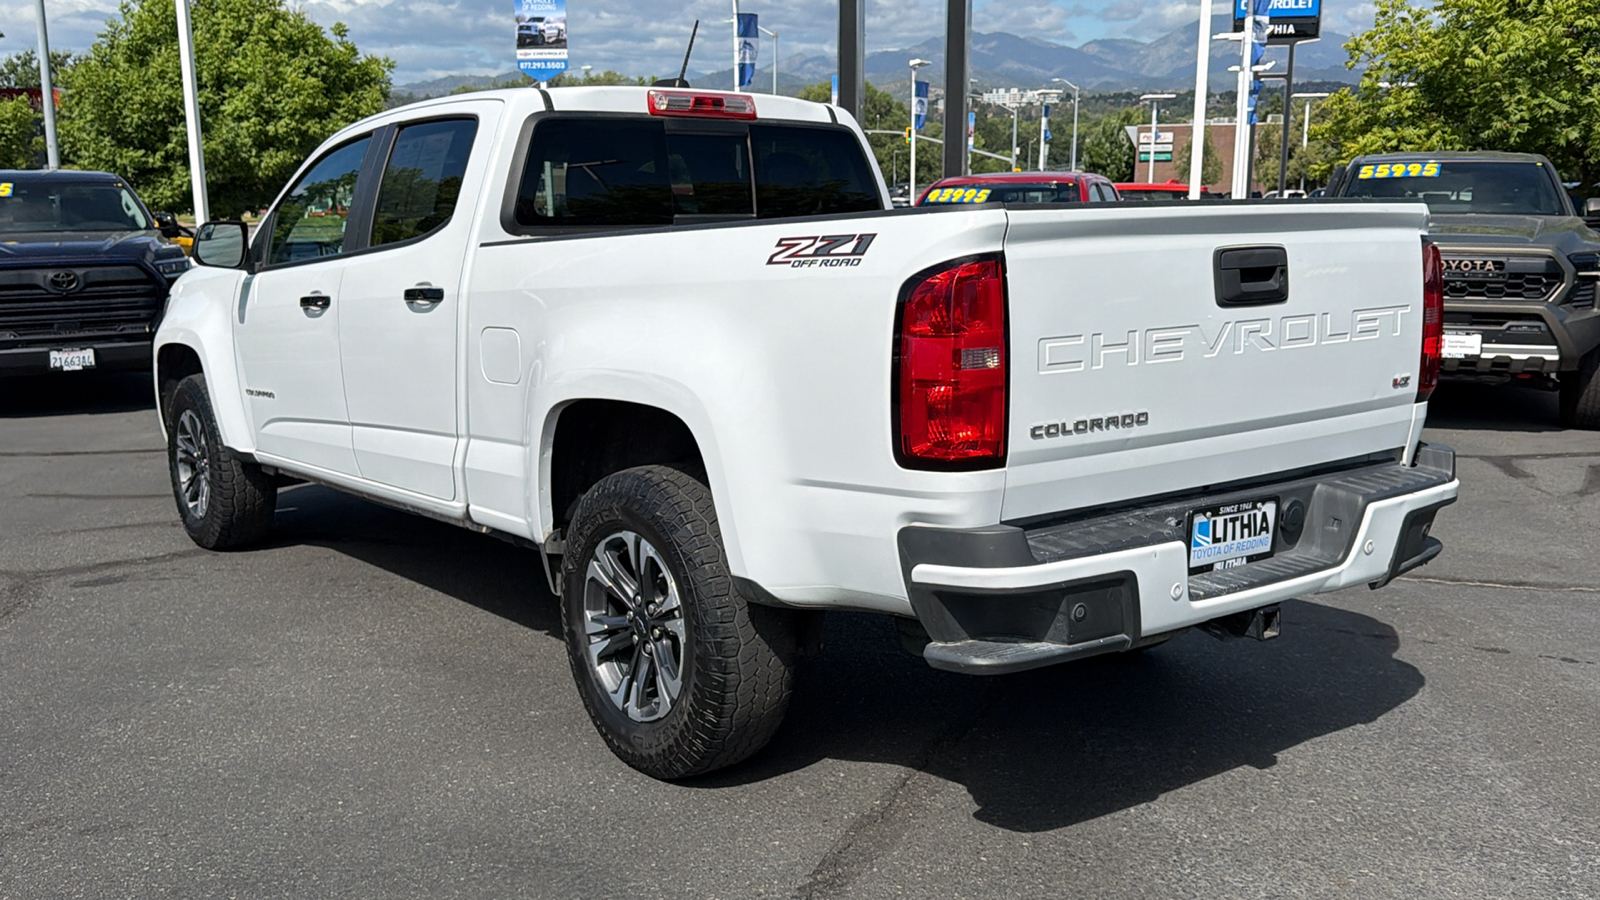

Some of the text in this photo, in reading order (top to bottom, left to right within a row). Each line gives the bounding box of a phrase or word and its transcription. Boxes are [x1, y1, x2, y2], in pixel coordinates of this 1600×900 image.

[520, 62, 565, 70] 877.293.5503
[1358, 163, 1440, 179] 55995
[927, 188, 991, 203] 43995
[766, 233, 878, 265] Z71
[791, 257, 862, 268] OFF ROAD
[1441, 260, 1495, 271] OYOTA
[1037, 304, 1411, 375] CHEVROLET
[1030, 411, 1149, 440] COLORADO
[1219, 505, 1238, 514] SINCE
[1212, 511, 1269, 544] LITHIA
[1192, 537, 1269, 560] TOYOTA OF REDDING
